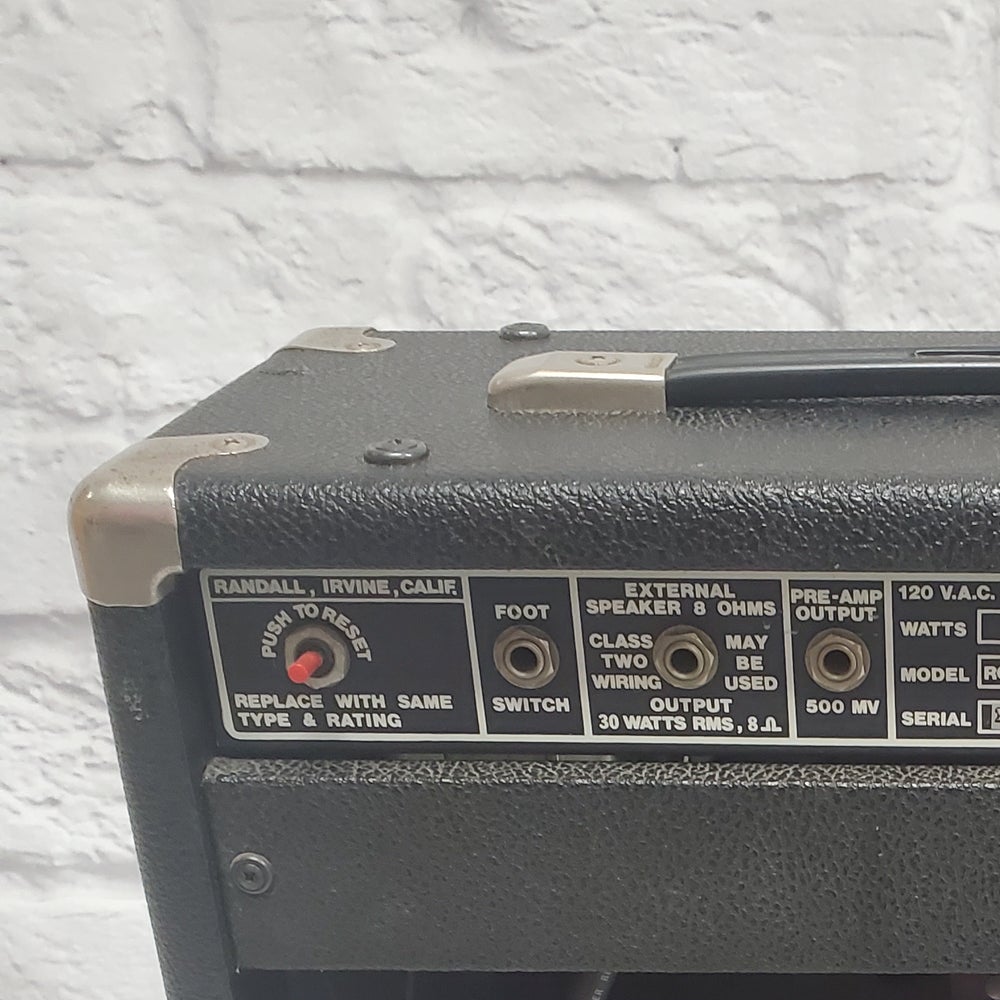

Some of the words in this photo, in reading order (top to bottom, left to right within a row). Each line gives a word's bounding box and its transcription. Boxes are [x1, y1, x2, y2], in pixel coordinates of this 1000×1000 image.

[214, 579, 316, 598] RANDALL,
[400, 579, 457, 596] CALIF.
[625, 582, 736, 599] EXTERNAL
[898, 585, 934, 601] 120
[940, 585, 996, 601] V.A.C.
[790, 588, 883, 606] PRE-AMP
[495, 604, 550, 620] FOOT
[586, 599, 681, 616] SPEAKER
[693, 600, 706, 616] 8
[717, 600, 777, 617] OHMS
[795, 605, 877, 622] OUTPUT
[262, 609, 292, 658] PUSH
[293, 604, 319, 619] TO
[321, 606, 372, 662] RESET
[900, 621, 967, 637] WATTS
[589, 633, 653, 650] CLASS
[725, 634, 768, 650] MAY
[601, 654, 649, 670] TWO
[736, 655, 763, 671] BE
[591, 674, 662, 691] WIRING
[724, 675, 778, 691] USED
[901, 667, 970, 683] MODEL
[234, 693, 324, 709] REPLACE
[335, 694, 386, 709] WITH
[398, 694, 453, 710] SAME
[492, 697, 570, 713] SWITCH
[649, 698, 732, 714] OUTPUT
[805, 700, 845, 715] 500
[852, 700, 880, 715] MV
[238, 713, 291, 728] TYPE
[303, 713, 317, 728] &
[326, 713, 402, 728] RATING
[598, 714, 620, 731] 30
[621, 715, 687, 732] WATTS
[692, 716, 743, 734] RMS,
[901, 712, 972, 728] SERIAL
